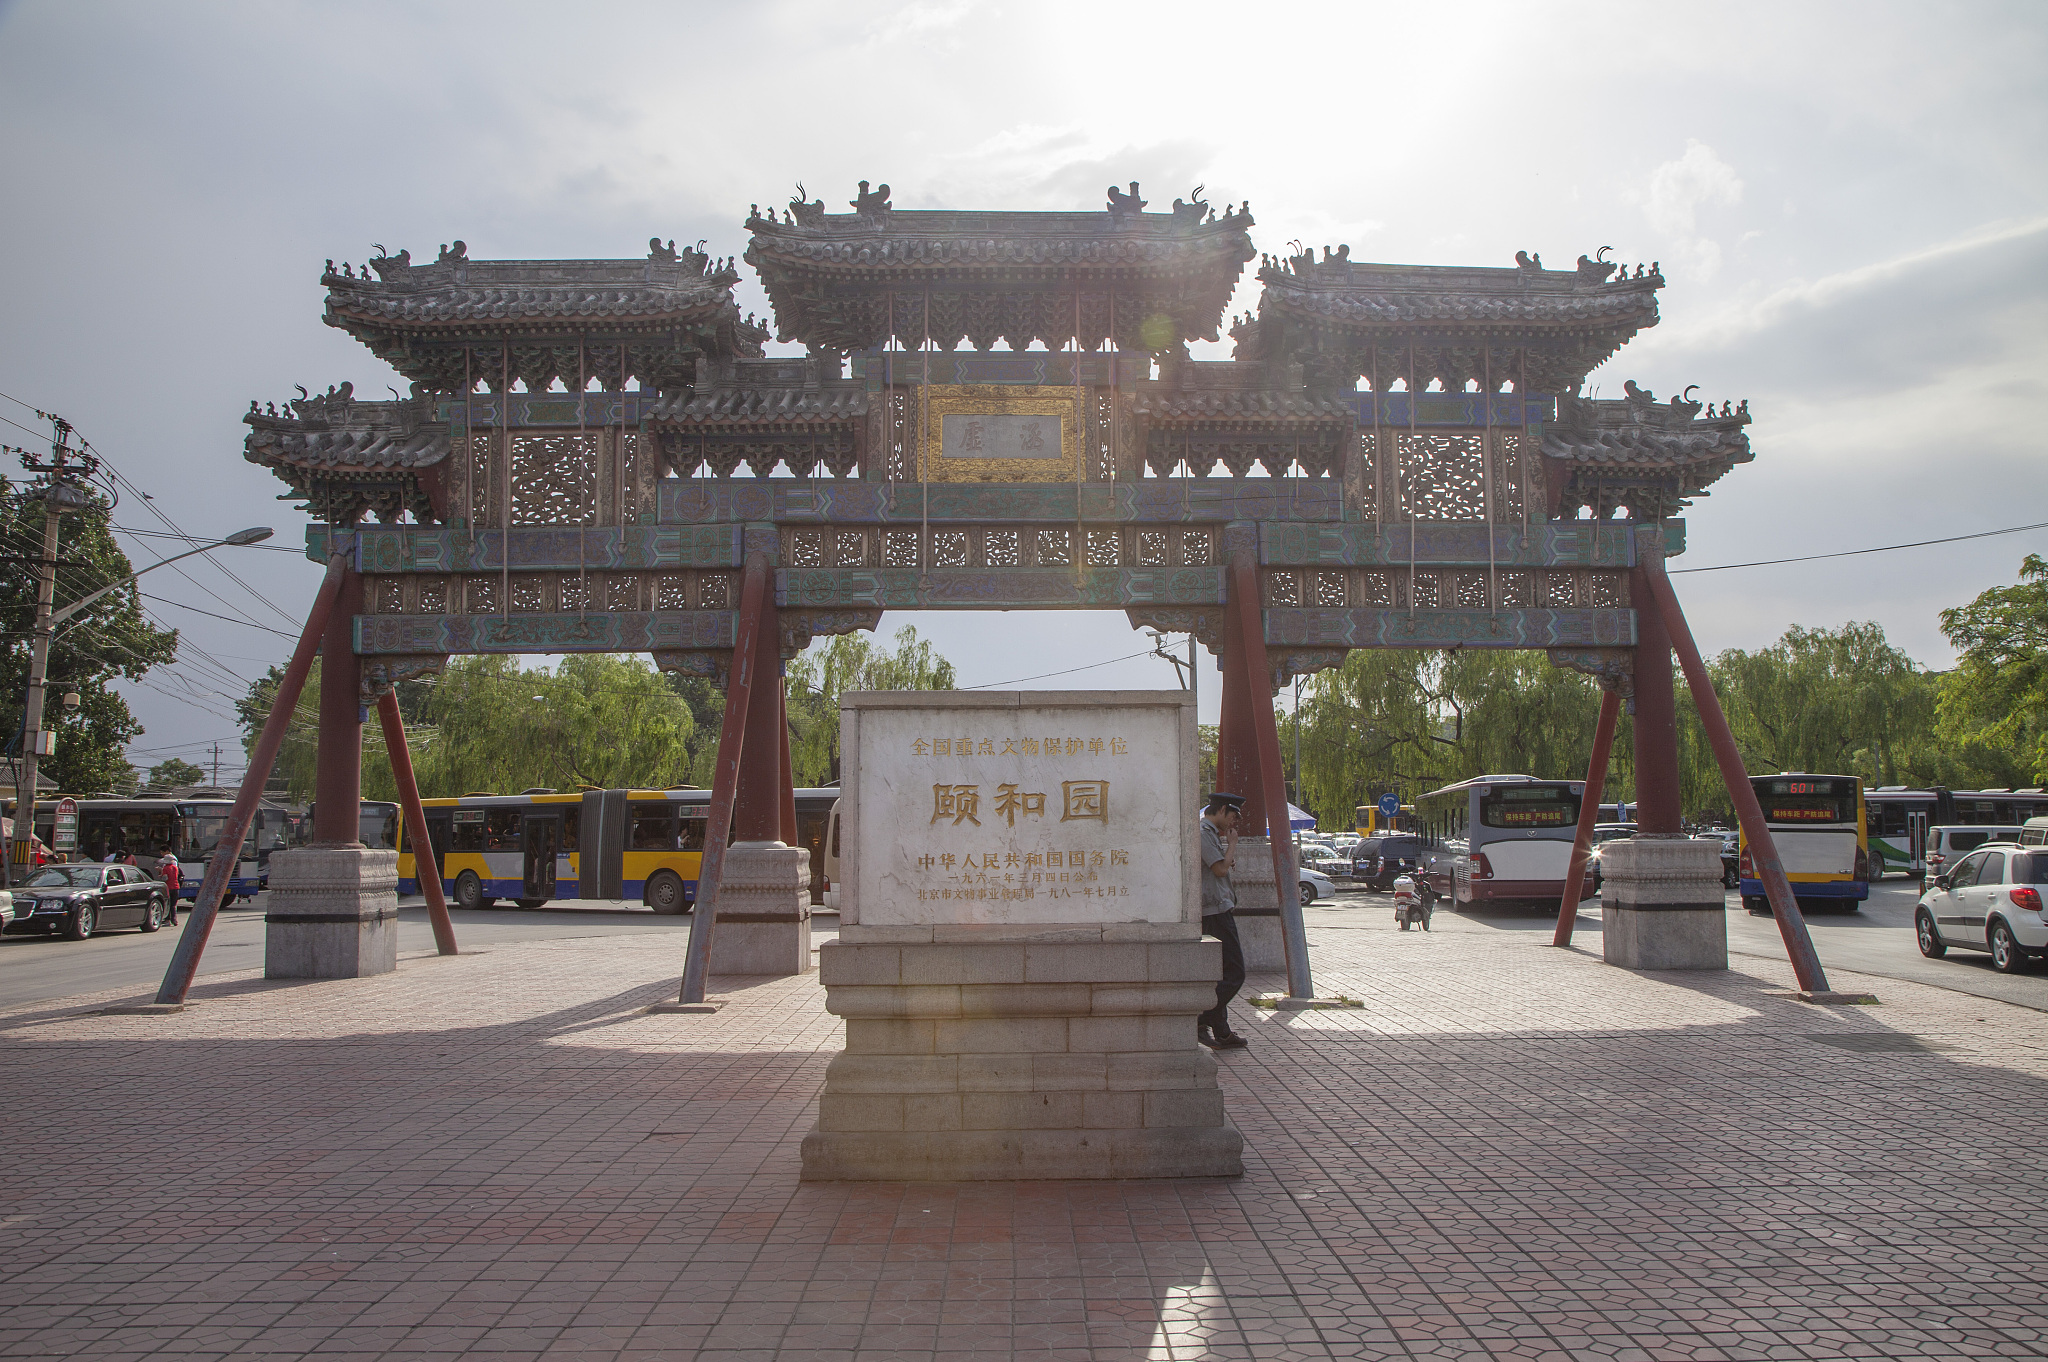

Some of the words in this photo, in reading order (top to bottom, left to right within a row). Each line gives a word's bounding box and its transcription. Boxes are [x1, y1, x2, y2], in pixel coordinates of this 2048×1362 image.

[911, 737, 1129, 757] 全国重点文物保护单位
[1790, 782, 1815, 794] 601
[929, 779, 1111, 828] 颐和园
[1505, 813, 1532, 821] 保持车距
[1773, 810, 1801, 818] 保持车距
[917, 849, 1130, 871] 中华人民共和国国务院
[947, 871, 1099, 885] 一九六一年三月四日公布
[917, 885, 1130, 901] 北京市文物事业管理局一九八一年七月立
